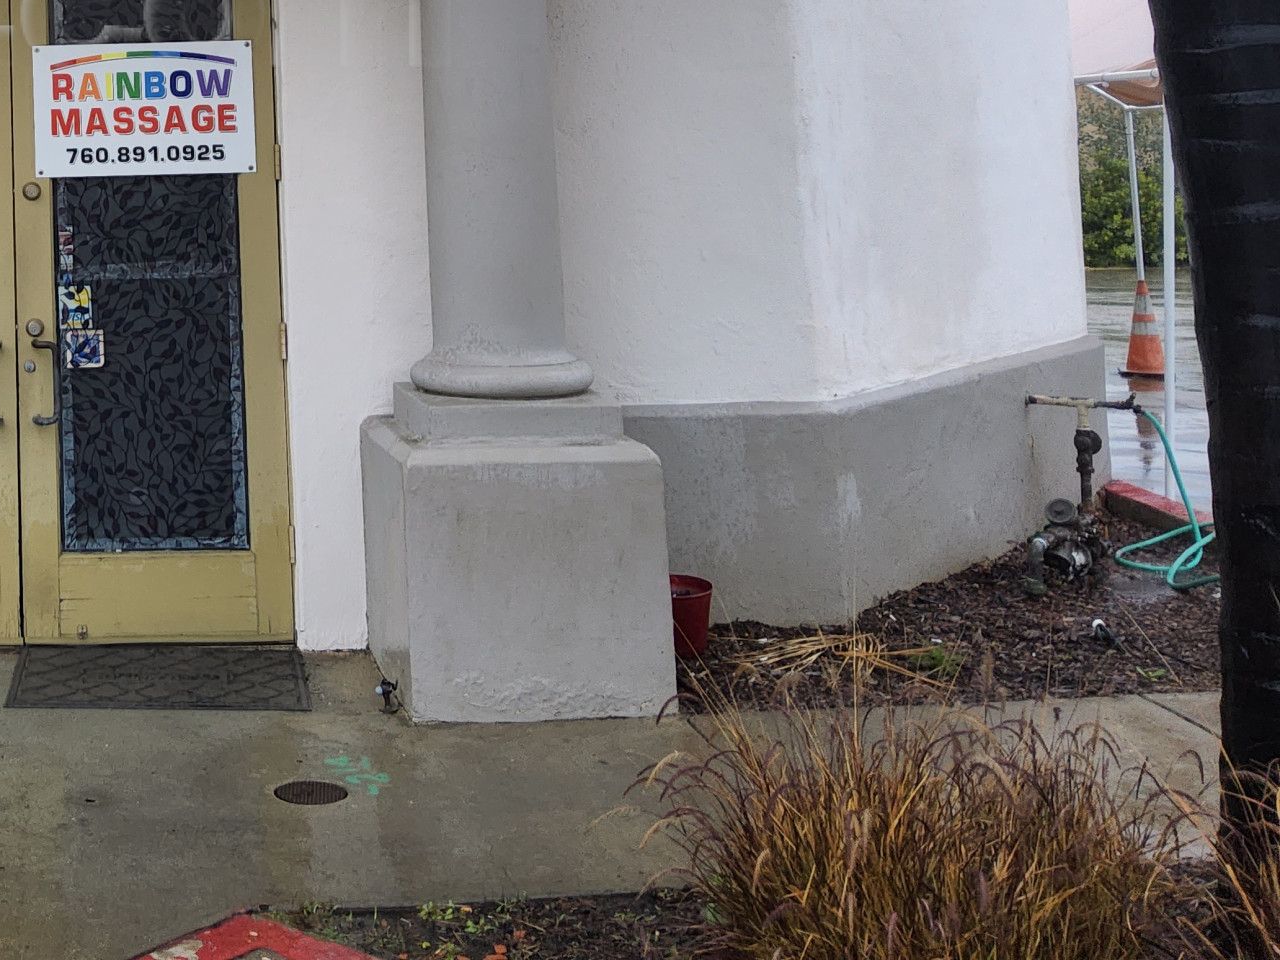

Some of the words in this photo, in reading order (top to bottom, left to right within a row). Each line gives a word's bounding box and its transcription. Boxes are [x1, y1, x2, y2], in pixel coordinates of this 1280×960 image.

[50, 68, 233, 103] RAINBOW
[50, 104, 238, 137] MASSAGE
[65, 144, 226, 165] 760.891.0925
